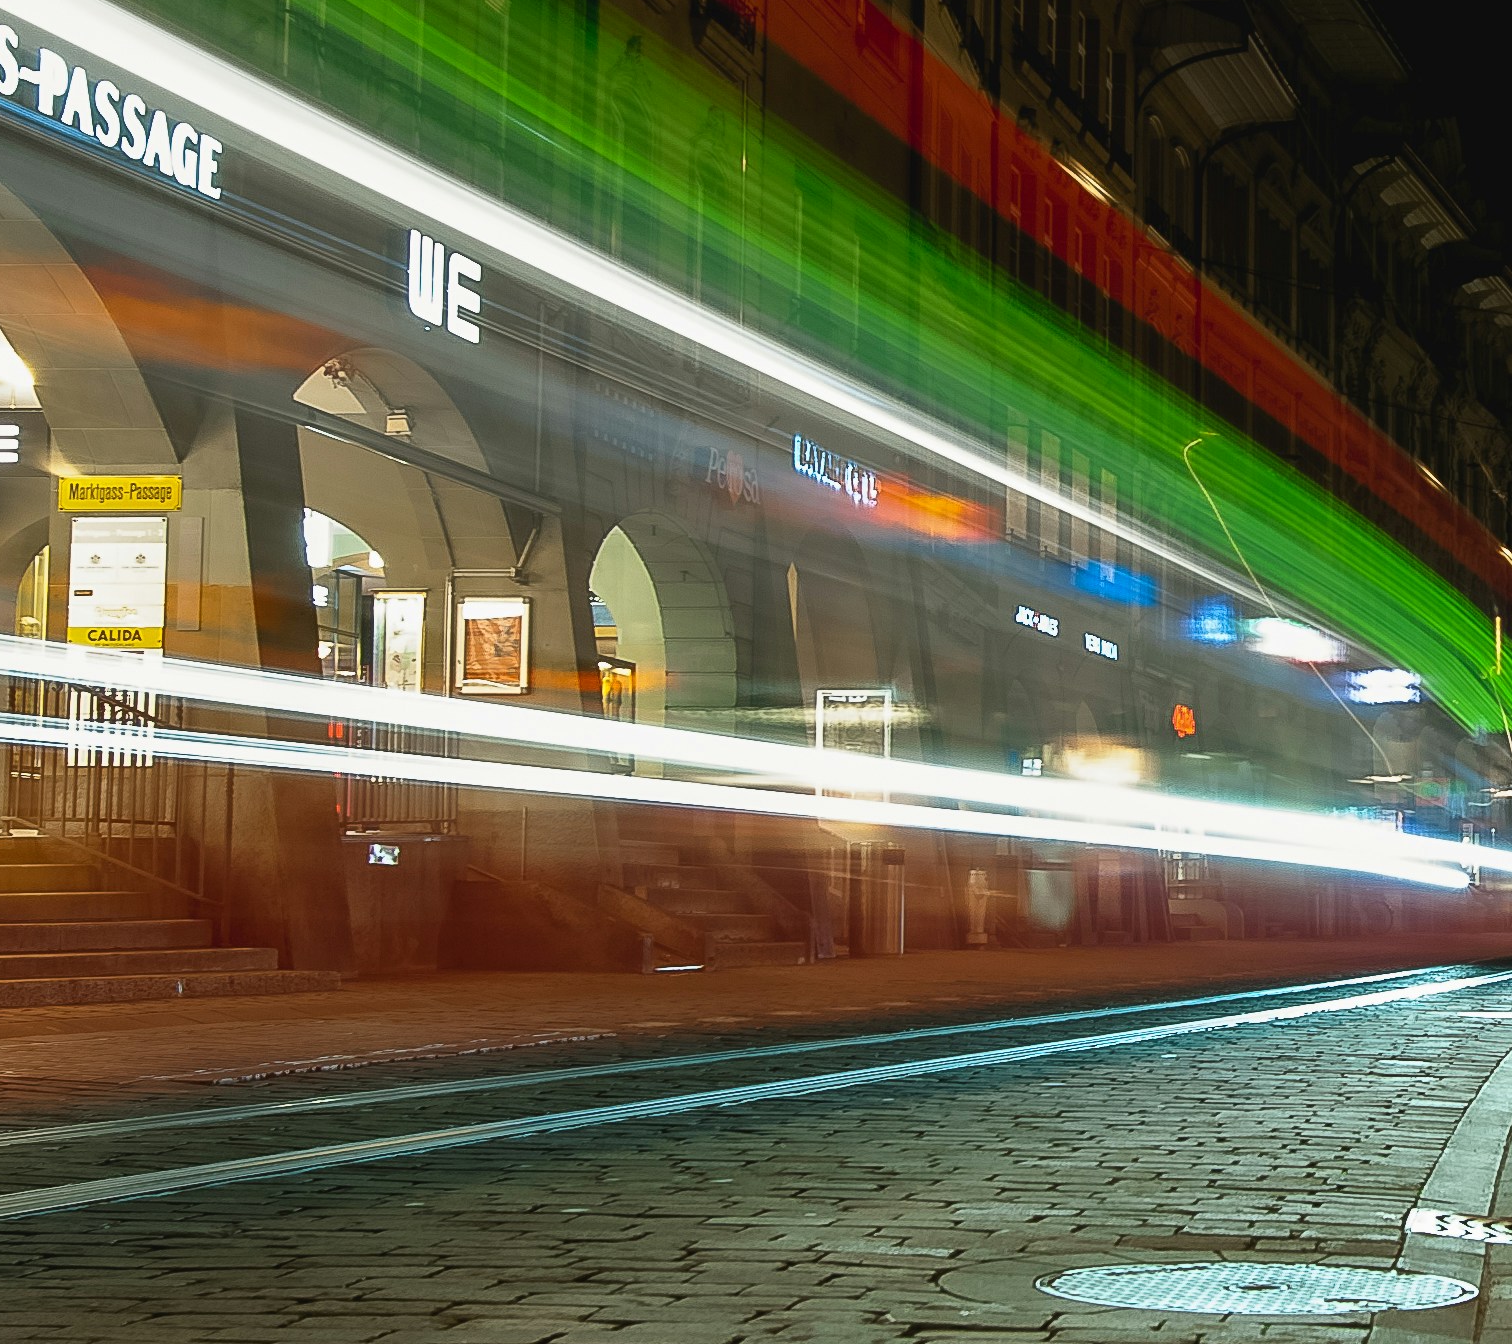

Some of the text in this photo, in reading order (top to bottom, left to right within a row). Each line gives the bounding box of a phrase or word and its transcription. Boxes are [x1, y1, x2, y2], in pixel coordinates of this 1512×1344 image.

[408, 229, 482, 344] WE
[69, 483, 172, 504] Marktgass-Passage
[88, 630, 142, 642] CALIDA
